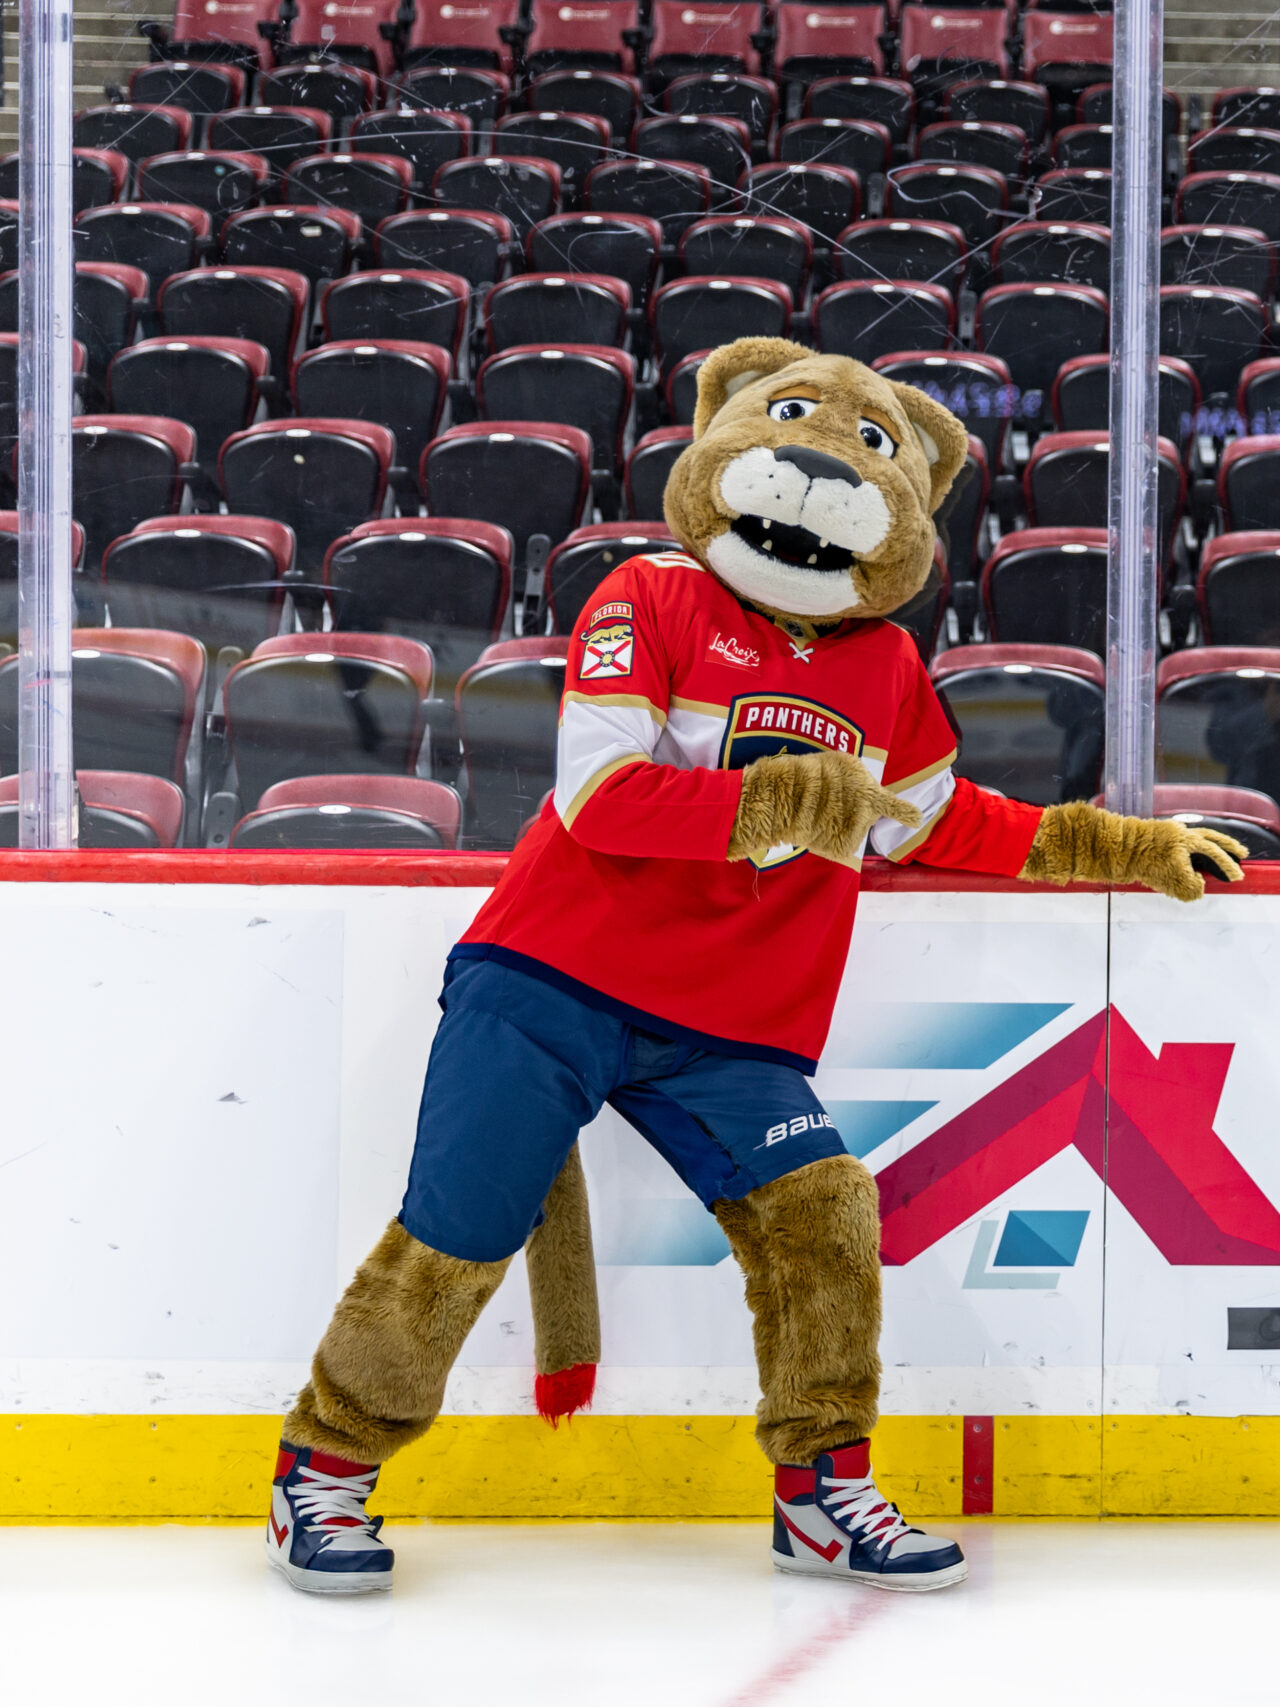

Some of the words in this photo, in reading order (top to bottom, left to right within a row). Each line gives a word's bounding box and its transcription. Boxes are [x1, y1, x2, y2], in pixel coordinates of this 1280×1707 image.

[594, 605, 628, 621] FLORIDA
[709, 632, 759, 666] LaCroix
[745, 706, 850, 752] PANTHERS
